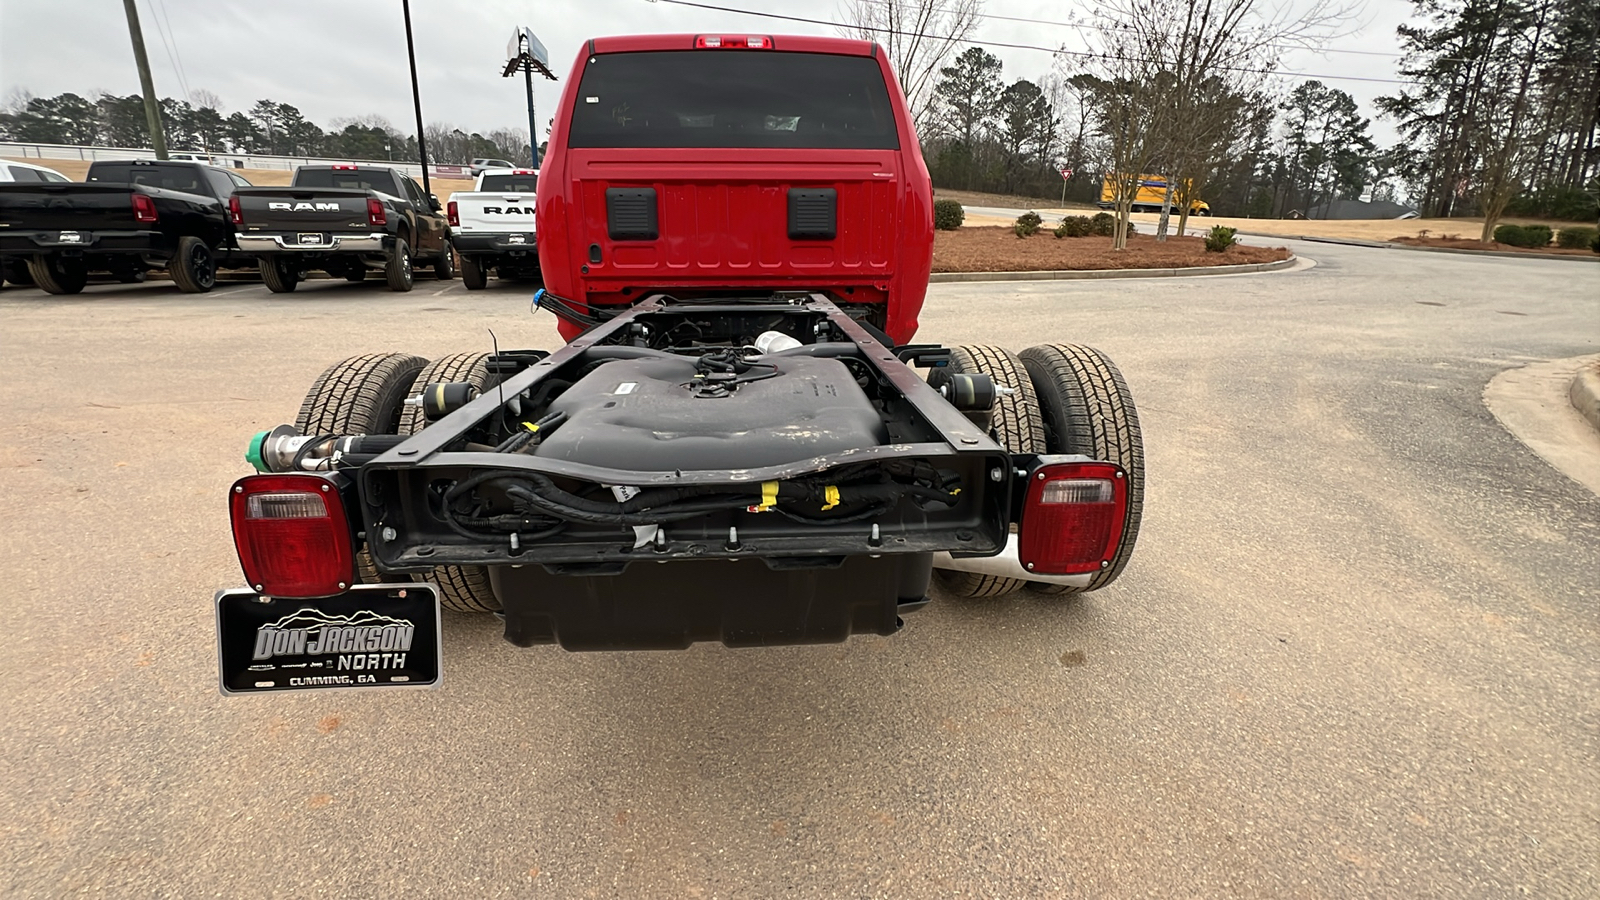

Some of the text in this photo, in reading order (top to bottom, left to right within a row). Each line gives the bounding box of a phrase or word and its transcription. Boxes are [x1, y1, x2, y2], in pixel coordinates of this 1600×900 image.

[268, 202, 340, 212] RAM
[252, 625, 414, 661] DON JACKSON
[337, 653, 406, 671] NORTH
[289, 674, 377, 687] CUMMING, GA
